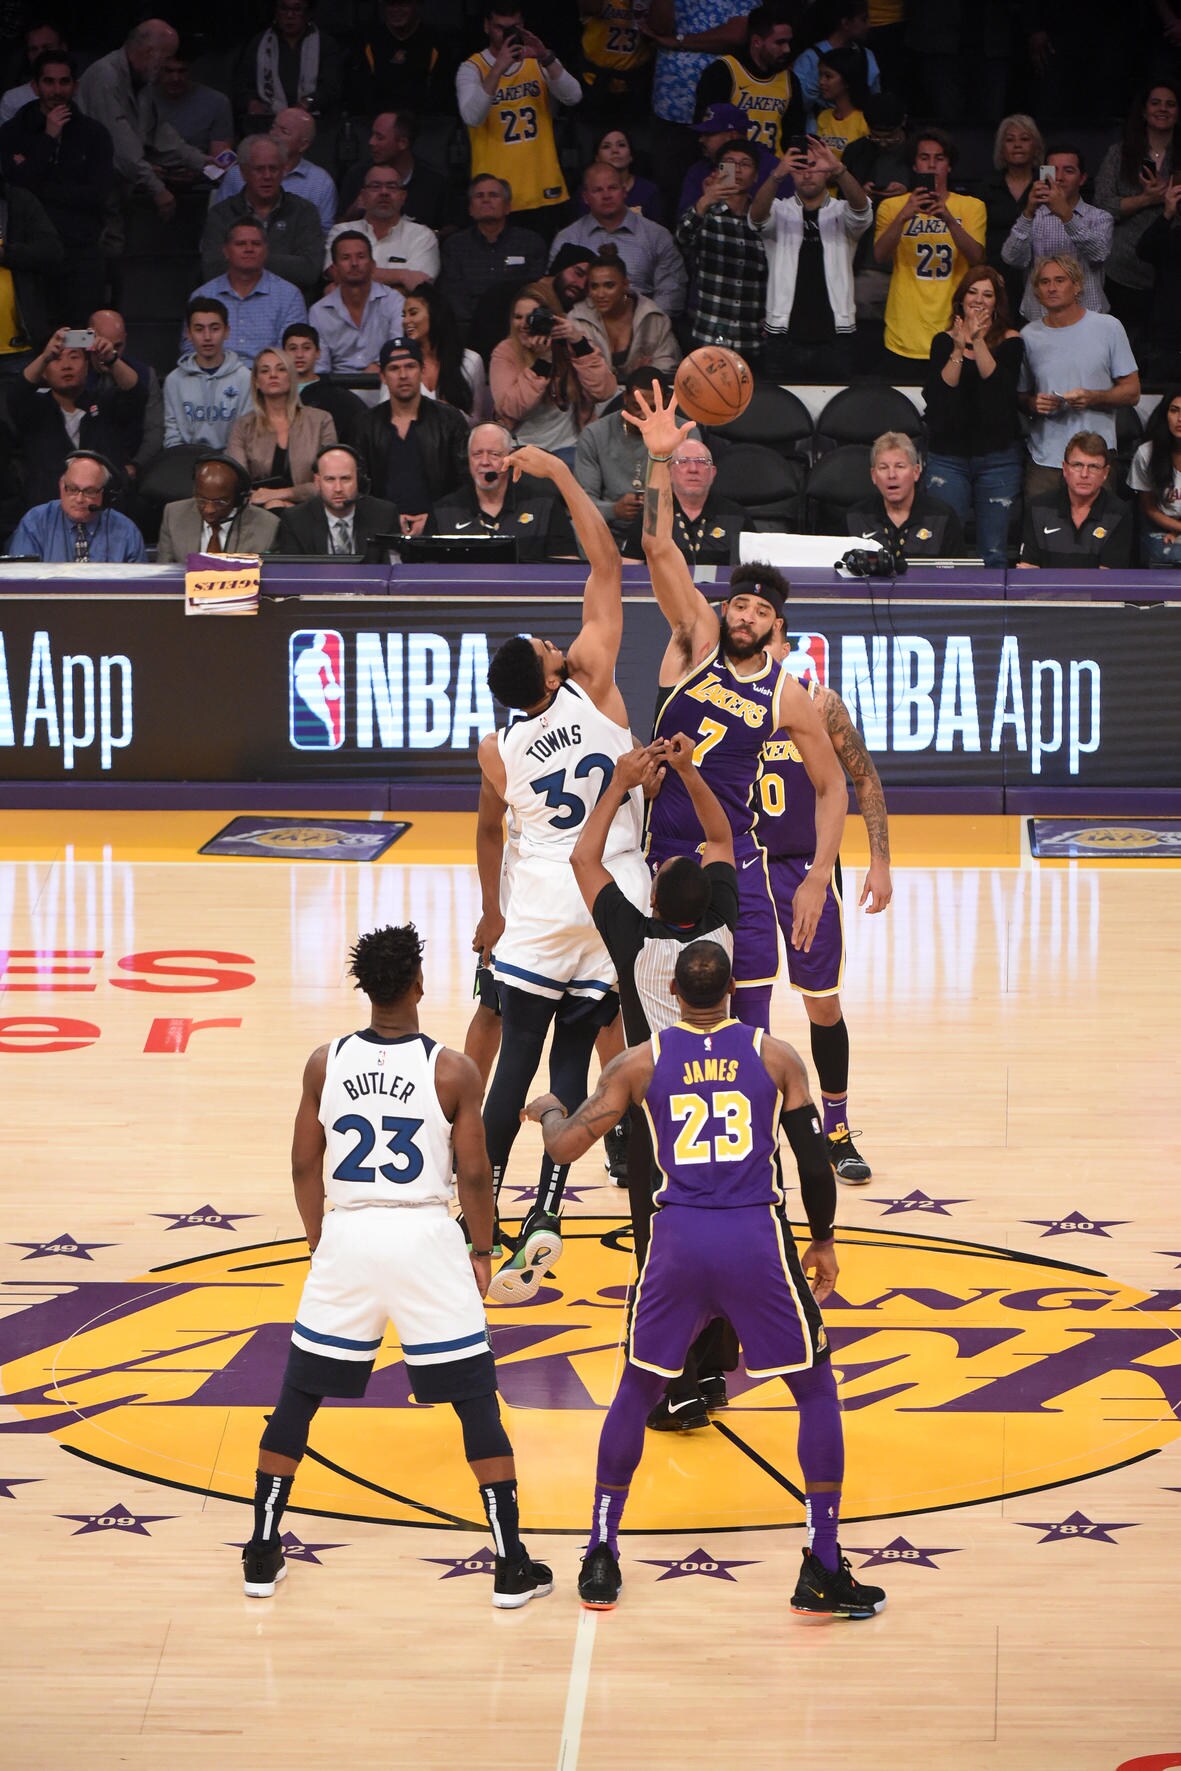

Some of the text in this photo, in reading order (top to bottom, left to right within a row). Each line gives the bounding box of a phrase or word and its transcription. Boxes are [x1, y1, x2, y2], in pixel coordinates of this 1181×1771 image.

[606, 25, 640, 54] 23
[500, 106, 537, 144] 23
[916, 244, 953, 280] 23
[24, 630, 133, 770] App
[356, 632, 496, 749] NBA
[684, 671, 768, 728] LAKERS
[752, 682, 773, 697] wish
[841, 635, 1101, 775] NBA App
[526, 724, 582, 764] TOWNS
[691, 716, 728, 767] 7
[529, 752, 632, 830] 32
[760, 773, 785, 817] 0
[0, 949, 256, 994] ES
[343, 1072, 416, 1104] BUTLER
[683, 1058, 740, 1085] JAMES
[669, 1090, 753, 1166] 23
[332, 1114, 425, 1184] 23
[179, 1214, 222, 1224] '50
[892, 1200, 935, 1209] '72
[1051, 1221, 1095, 1230] '80
[39, 1243, 79, 1253] '49
[89, 1515, 136, 1528] '09
[1050, 1524, 1098, 1534] '87
[671, 1561, 719, 1572] '00
[872, 1549, 921, 1560] '88
